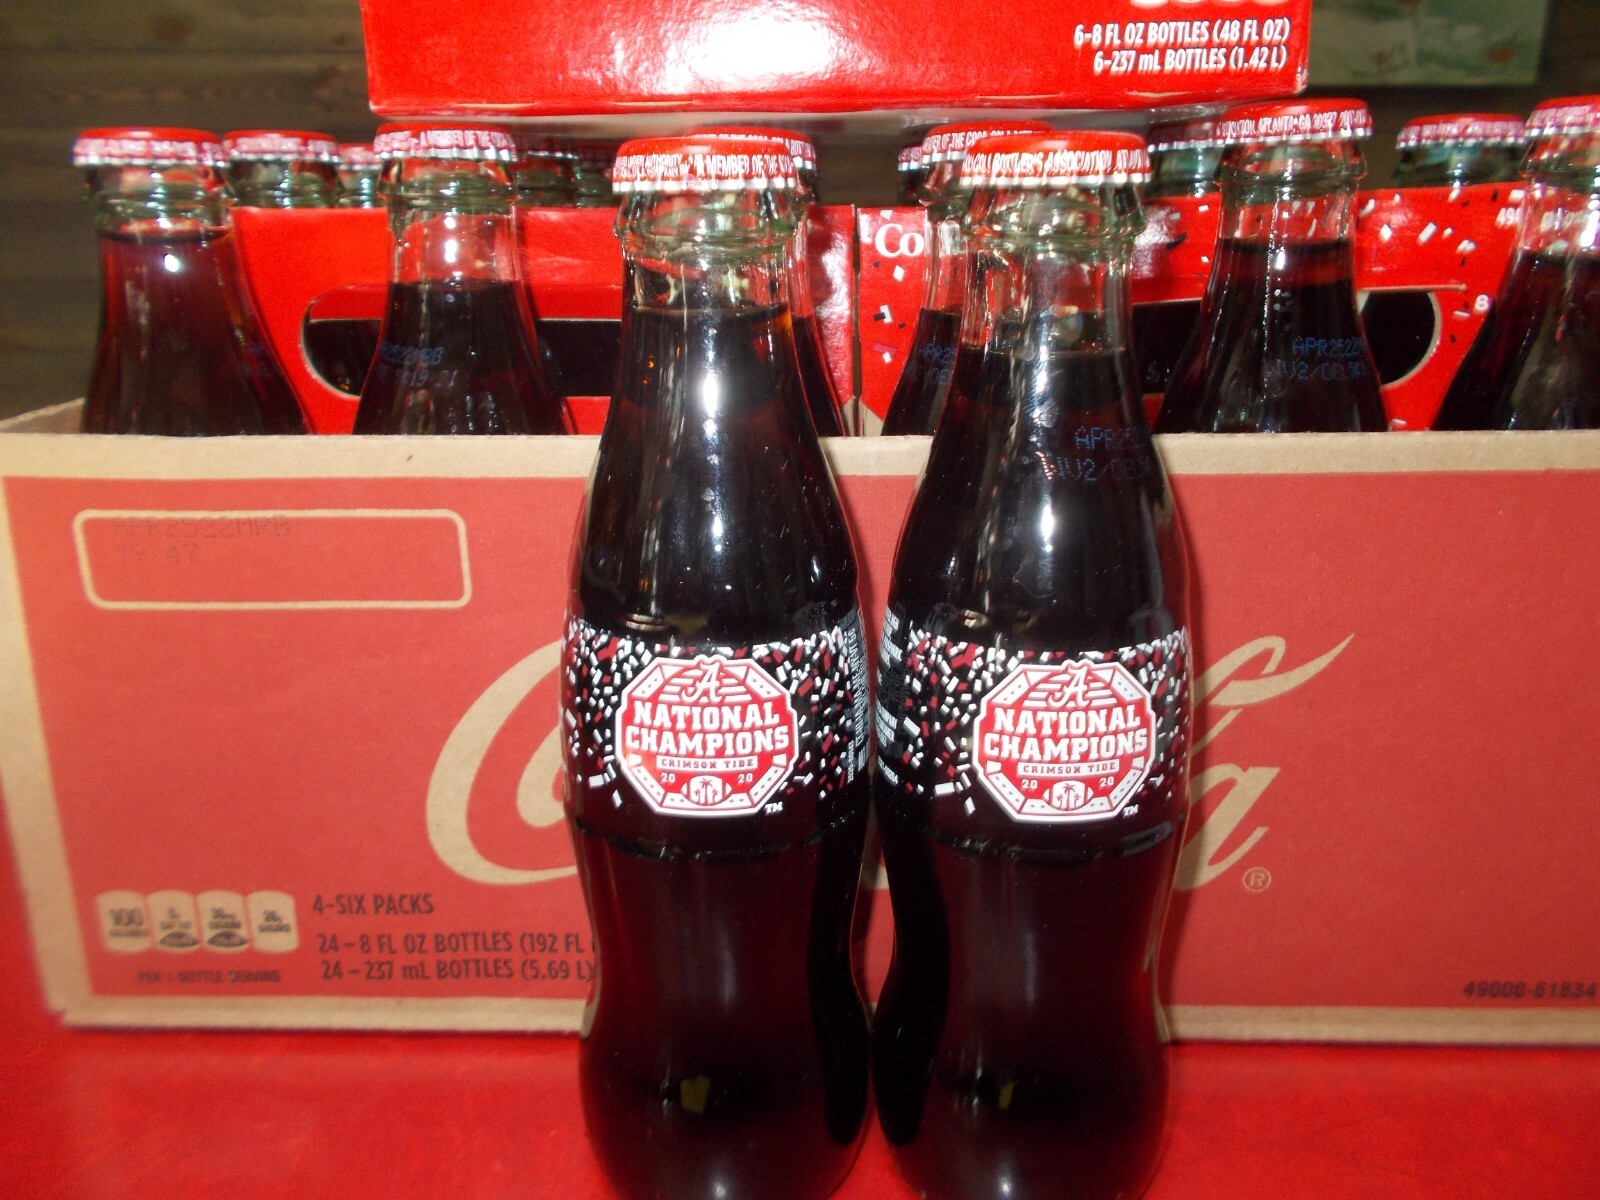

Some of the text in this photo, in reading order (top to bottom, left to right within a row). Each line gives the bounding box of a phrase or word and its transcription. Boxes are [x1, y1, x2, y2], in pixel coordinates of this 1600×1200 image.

[1074, 17, 1291, 46] 6-8 FL OZ BOTTLES (48 FL OZ)
[1093, 45, 1288, 74] 6-237 mL BOTTLES (1.42 L)
[706, 154, 750, 177] MEMBER
[633, 700, 780, 731] NATIONAL
[993, 704, 1141, 735] NATIONAL
[625, 725, 790, 757] CHAMPIONS
[983, 727, 1148, 762] CHAMPIONS
[661, 758, 754, 769] CRIMSON TIDE
[1023, 761, 1117, 774] CRIMSON TIDE
[660, 772, 754, 784] 20 20
[1021, 776, 1115, 790] 20 20
[312, 893, 435, 915] 4-SIX PACKS
[377, 933, 397, 954] FL
[403, 933, 427, 954] OZ
[434, 932, 513, 954] BOTTLES
[519, 931, 558, 955] (192
[565, 932, 585, 953] FL
[402, 960, 429, 980] mL
[437, 958, 514, 980] BOTTLES
[520, 958, 570, 982] (5.69
